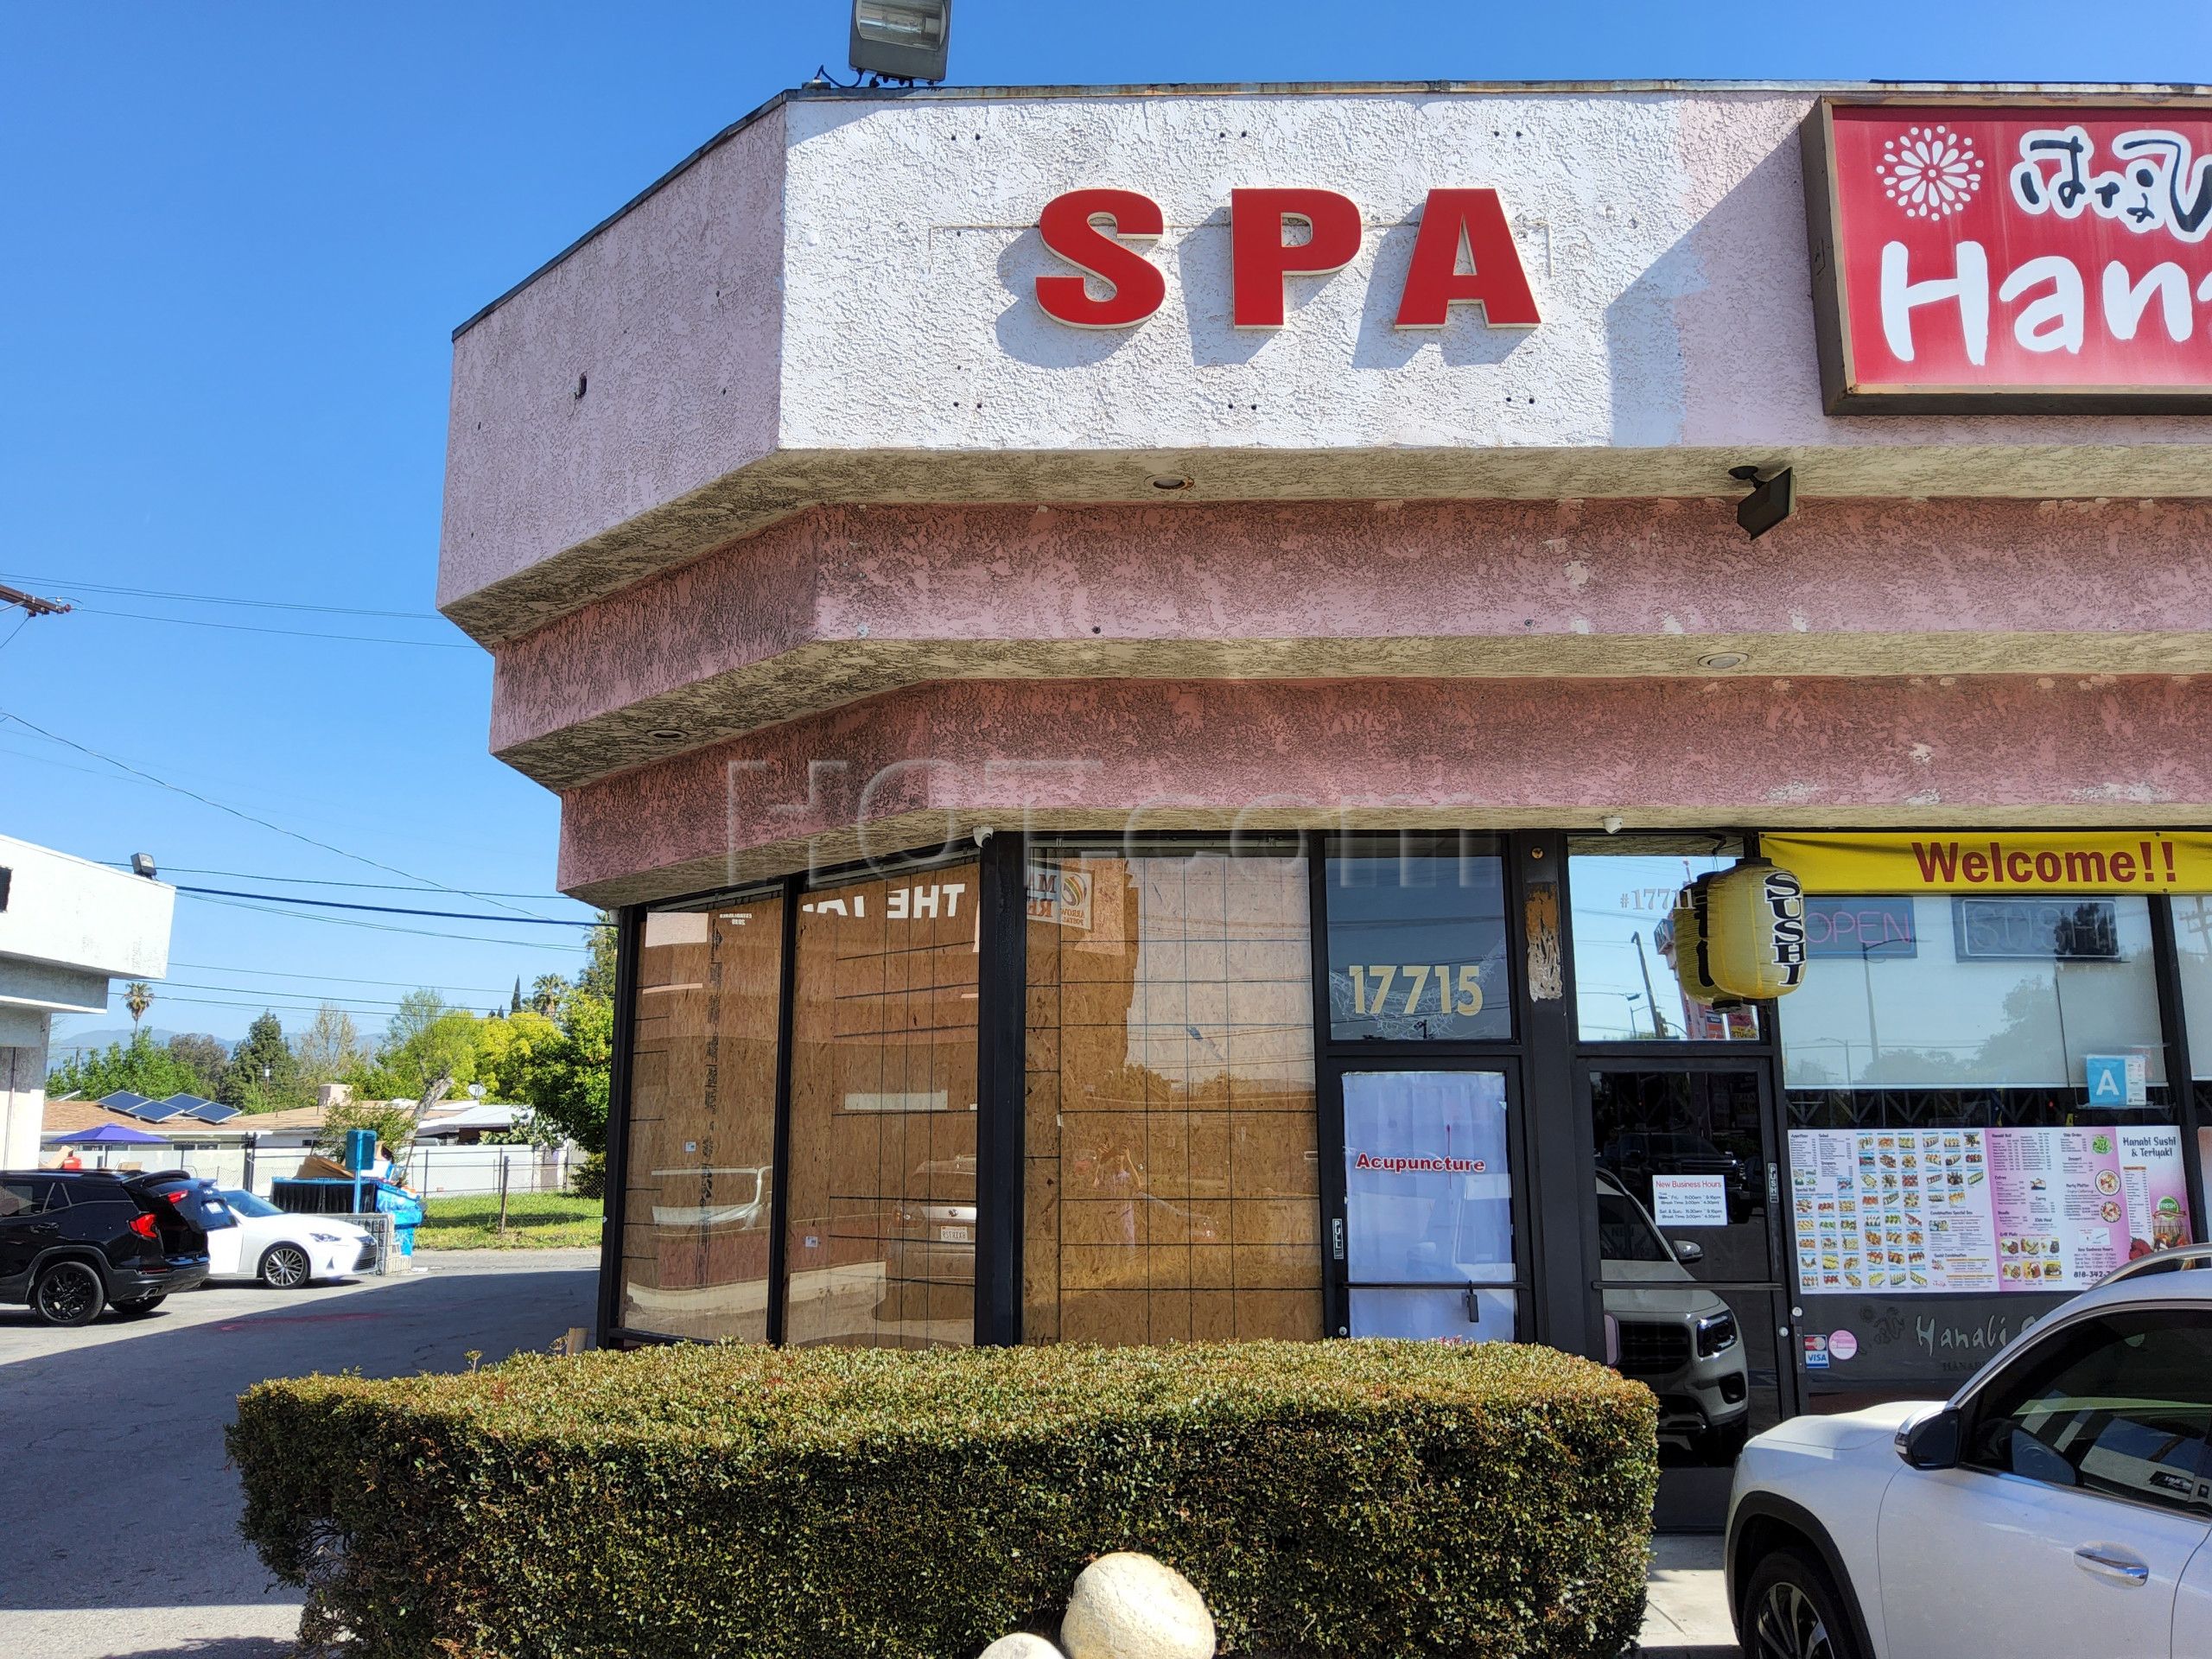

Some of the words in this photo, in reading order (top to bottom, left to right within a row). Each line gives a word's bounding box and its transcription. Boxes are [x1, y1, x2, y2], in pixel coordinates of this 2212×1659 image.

[1035, 188, 1541, 330] SPA
[1880, 240, 2212, 365] Han
[1911, 842, 2177, 882] Welcome!!
[1764, 872, 1807, 988] SUSHI
[1804, 911, 1911, 944] OPEN
[1971, 906, 2113, 951] SUSHI
[1349, 964, 1484, 1017] 17715
[2096, 1070, 2120, 1096] A
[2123, 1137, 2151, 1146] Hanabi
[2153, 1137, 2176, 1146] Sushi
[2139, 1147, 2172, 1159] Teriyaki
[1356, 1153, 1485, 1173] Acupuncture
[1916, 1314, 2005, 1357] Hanabi
